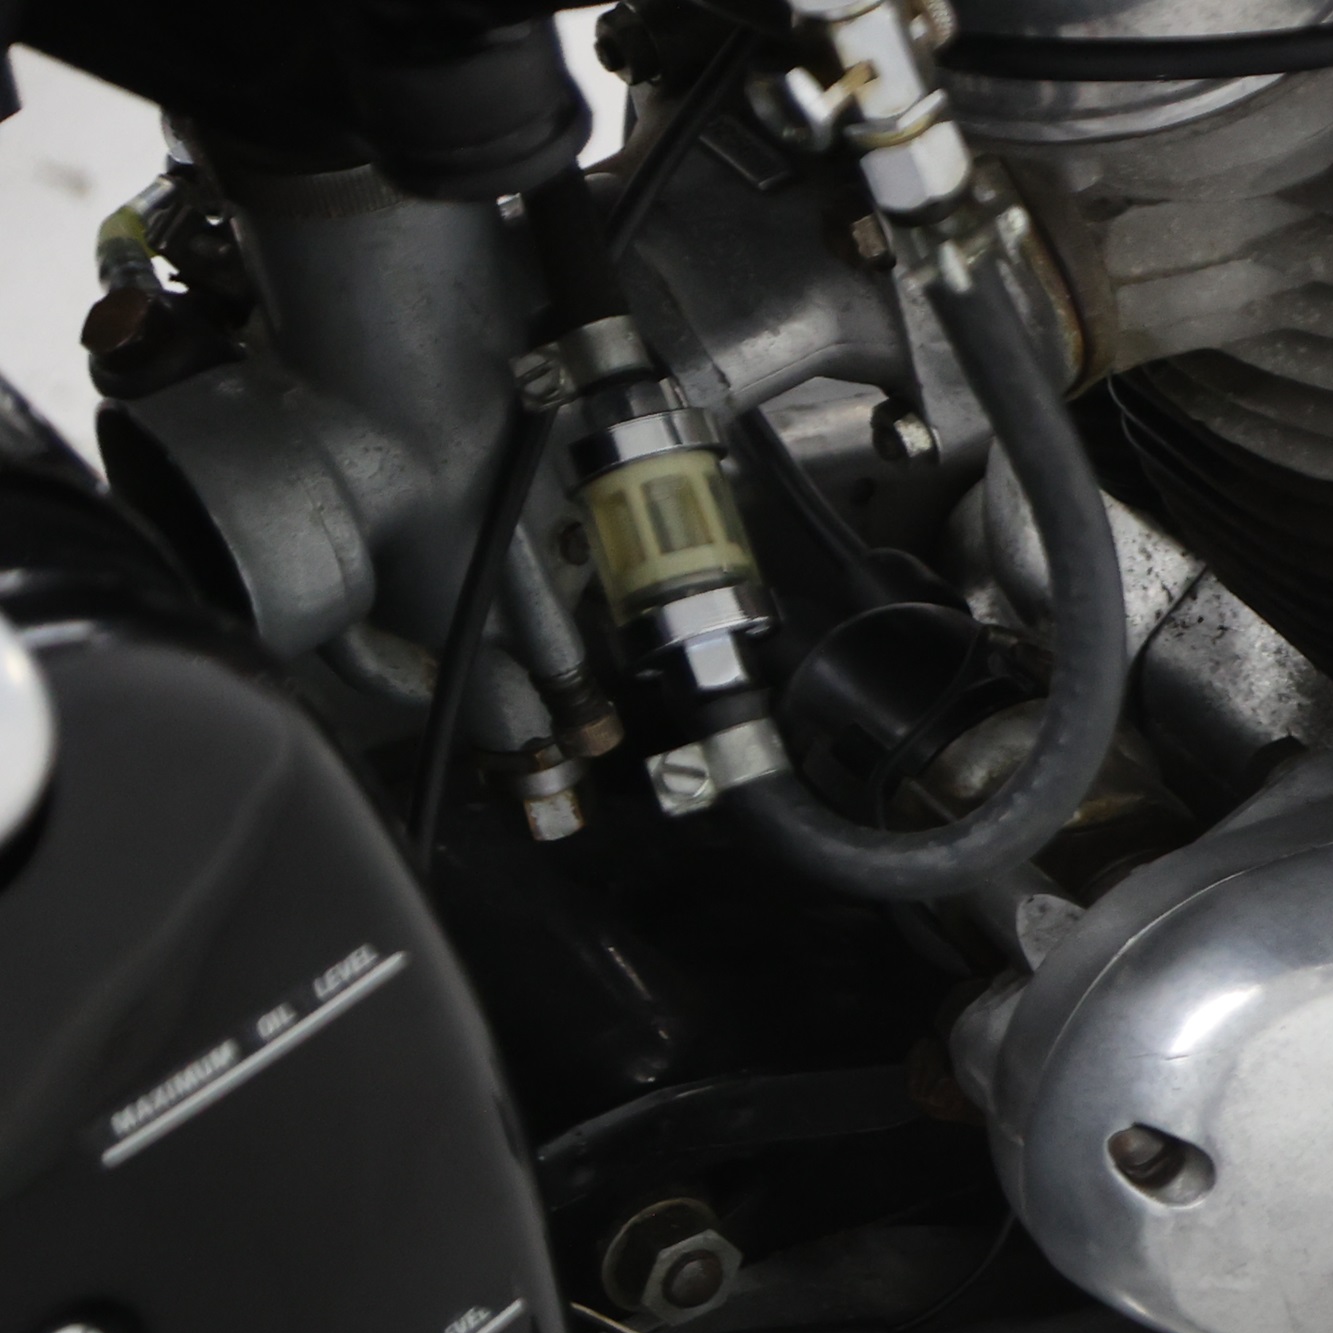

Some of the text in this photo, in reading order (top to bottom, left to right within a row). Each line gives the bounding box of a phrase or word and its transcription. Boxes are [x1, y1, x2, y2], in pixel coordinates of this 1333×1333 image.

[110, 943, 378, 1136] MAXIMUM OIL LEVEL
